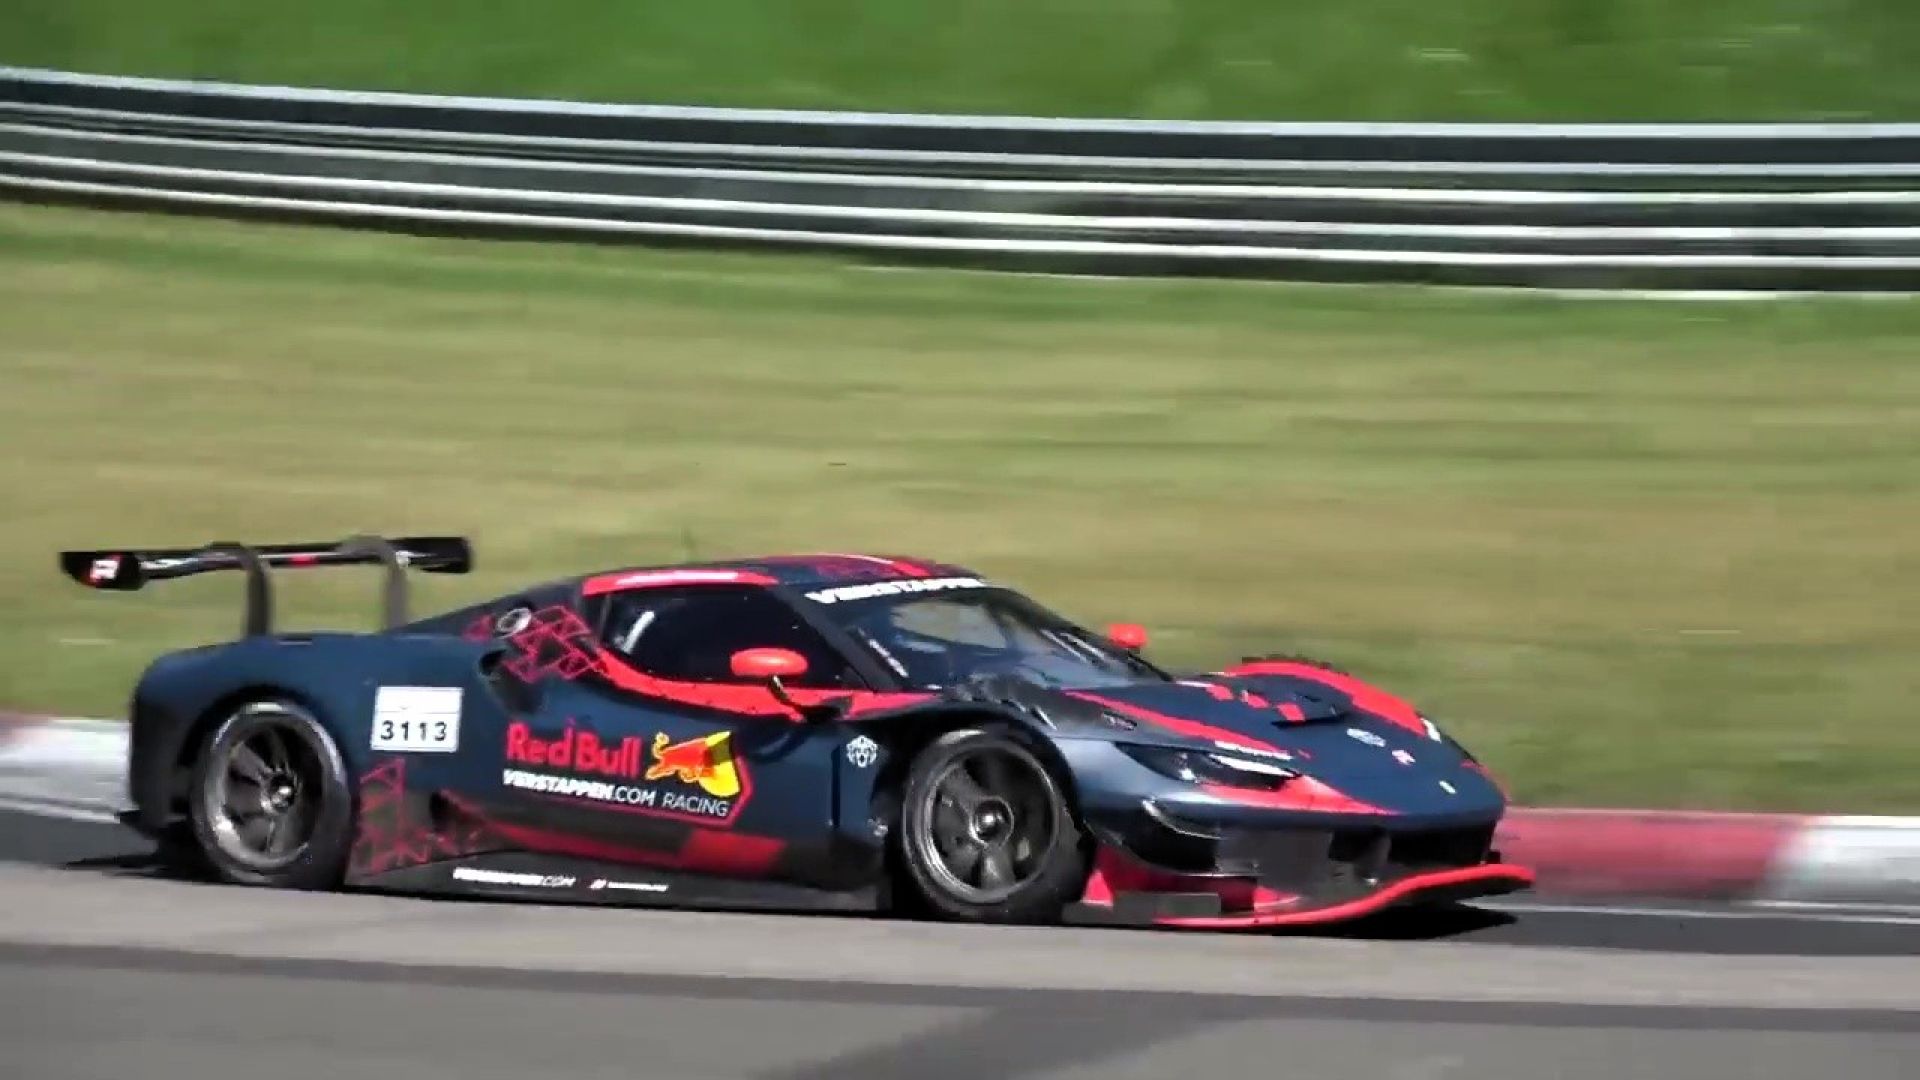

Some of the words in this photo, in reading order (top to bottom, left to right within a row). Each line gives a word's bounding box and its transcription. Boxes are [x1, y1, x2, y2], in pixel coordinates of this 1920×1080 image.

[380, 720, 448, 742] 3113
[506, 720, 574, 768] Red
[575, 730, 643, 779] Bull
[502, 768, 657, 808] VERSTAPPEN.COM
[661, 791, 730, 817] RACING
